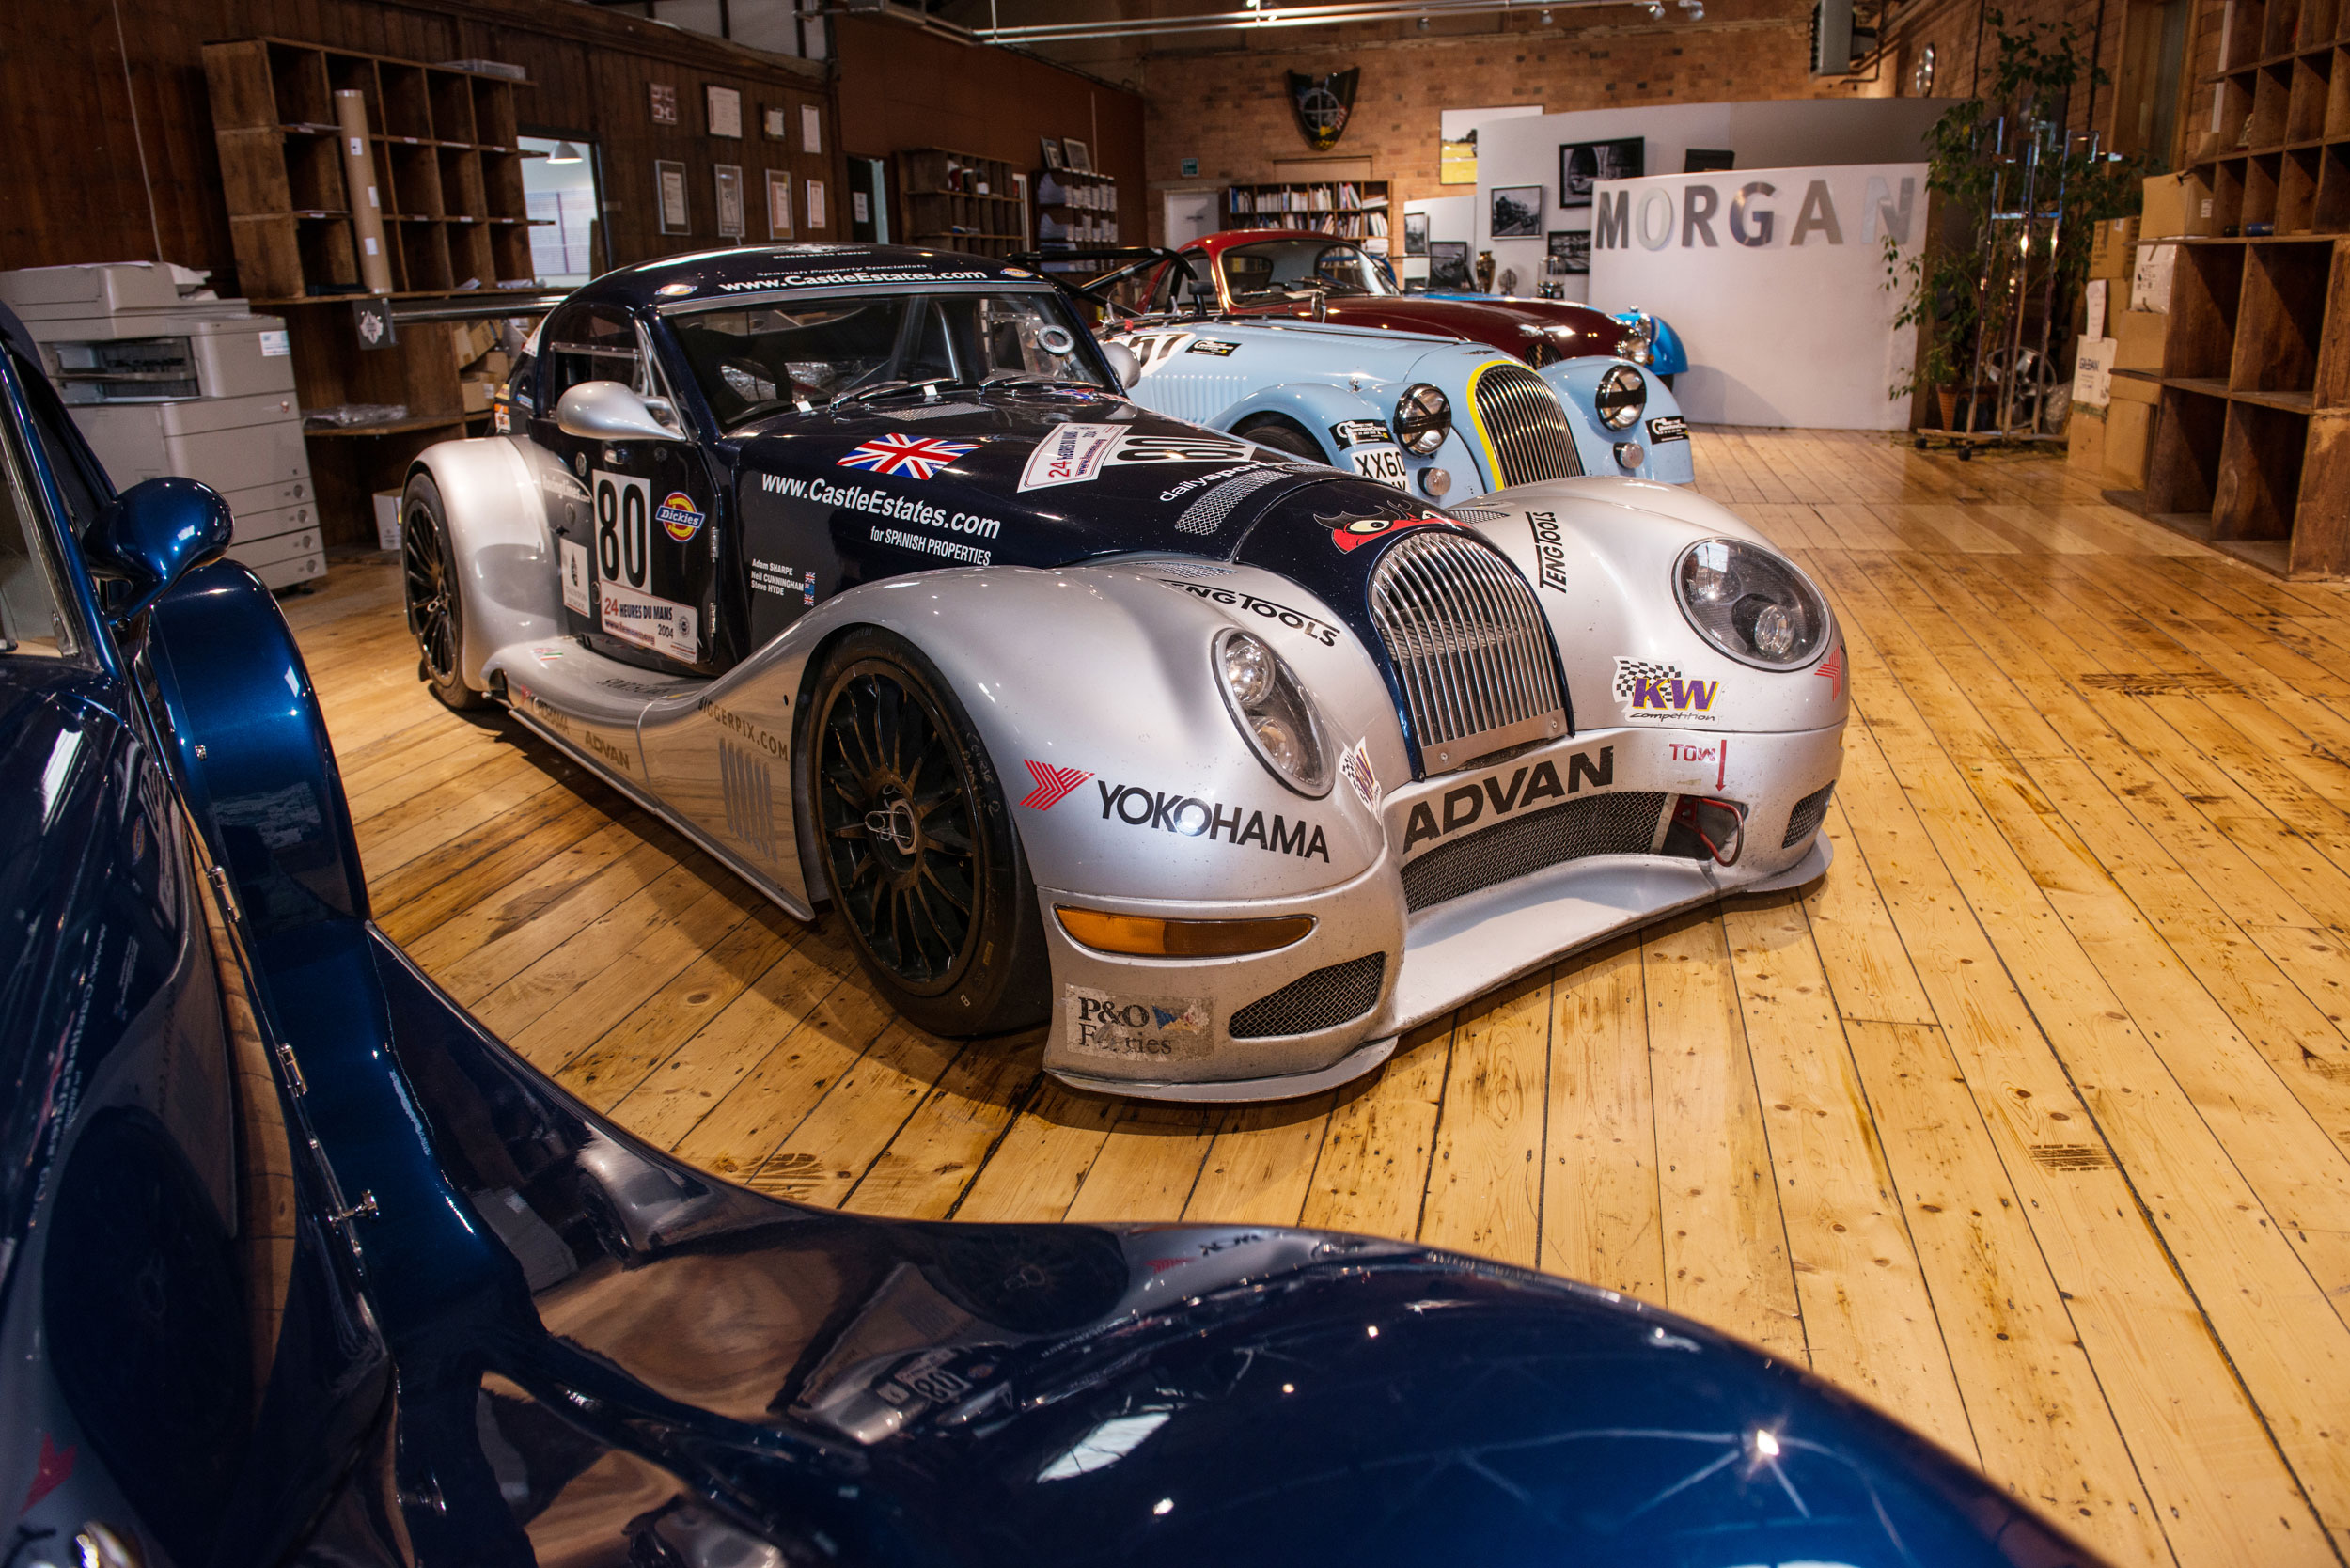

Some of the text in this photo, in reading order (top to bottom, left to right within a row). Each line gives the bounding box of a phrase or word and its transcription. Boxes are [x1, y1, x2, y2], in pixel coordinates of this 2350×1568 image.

[1594, 176, 1916, 252] MORGAN
[718, 271, 988, 292] www.CastleEstates.com
[1116, 437, 1247, 462] 80
[1048, 461, 1072, 478] 24
[660, 509, 699, 526] Dickies
[762, 473, 1001, 539] www.CastleEstates.com
[598, 479, 647, 588] 80
[870, 526, 992, 566] for SPANISH PROPERTIES
[751, 571, 805, 592] Neil CUNNINGHAM
[752, 558, 793, 575] Adam SHARPE
[751, 581, 785, 596] Steve HYDE
[604, 597, 673, 621] 24 HEURES DU MANS
[1159, 579, 1340, 647] NGTOOLS
[658, 623, 674, 640] 2004
[1632, 677, 1720, 712] KW
[697, 695, 789, 762] BIGGERPIX.COM
[585, 730, 631, 771] ADVAN
[1669, 743, 1716, 762] TOW
[1402, 745, 1614, 855] ADVAN
[1097, 778, 1330, 864] YOKOHAMA
[1077, 996, 1150, 1028] P&O
